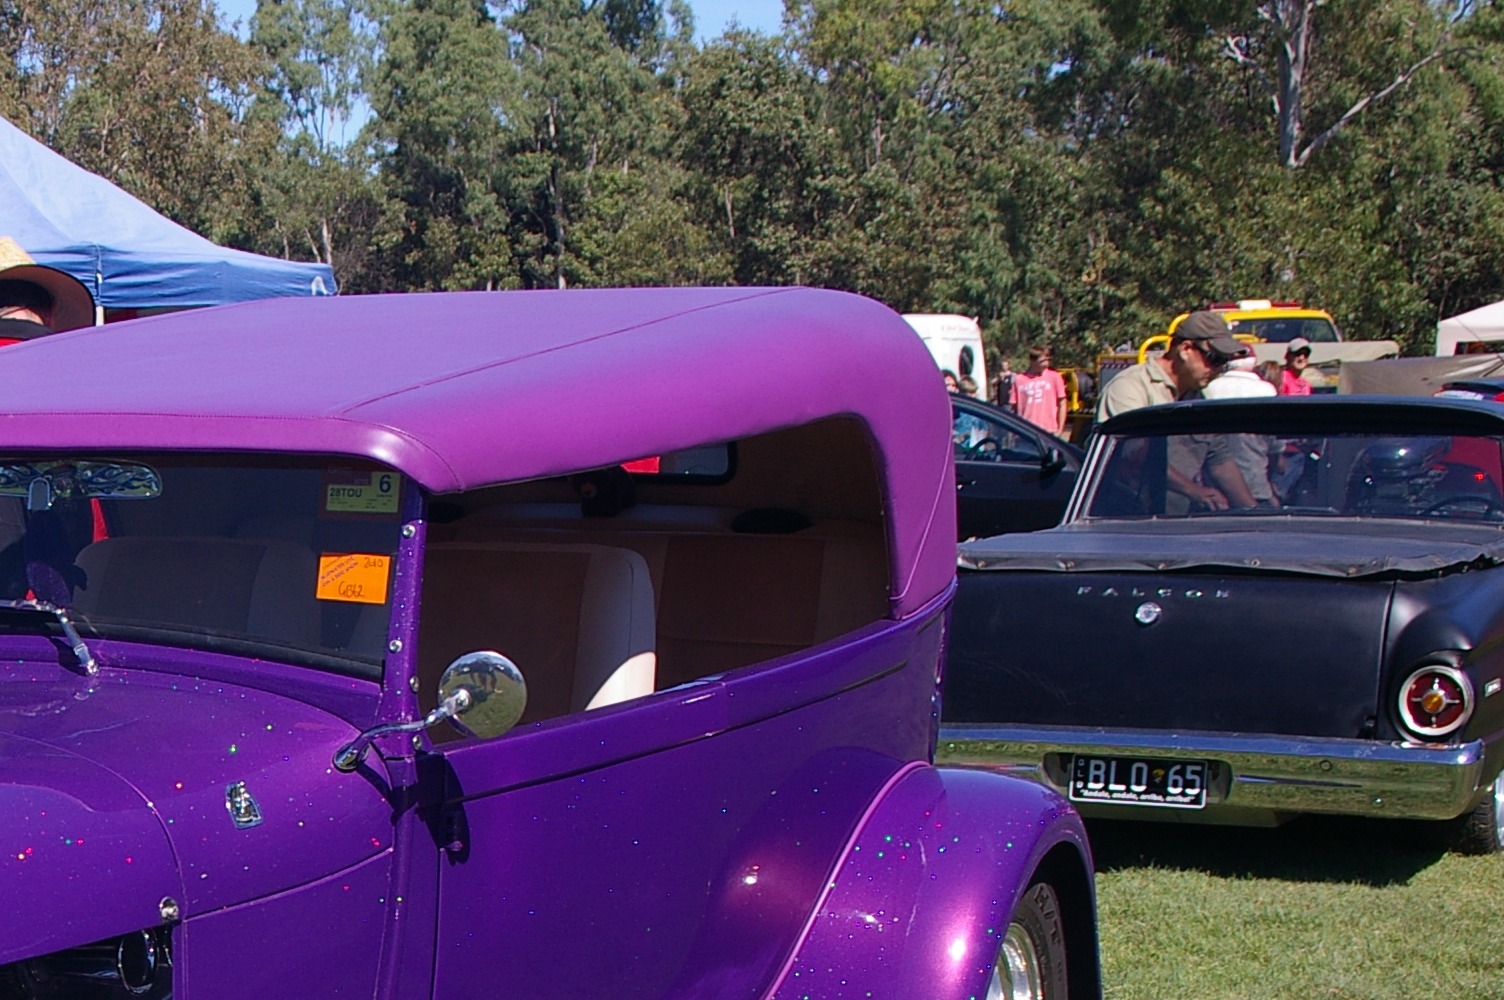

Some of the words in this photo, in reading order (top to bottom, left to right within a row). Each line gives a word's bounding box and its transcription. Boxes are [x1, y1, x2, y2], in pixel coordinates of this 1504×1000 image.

[379, 474, 391, 493] 6
[329, 488, 362, 498] 28TOU
[1076, 586, 1231, 599] FALCON
[1167, 764, 1203, 795] 65
